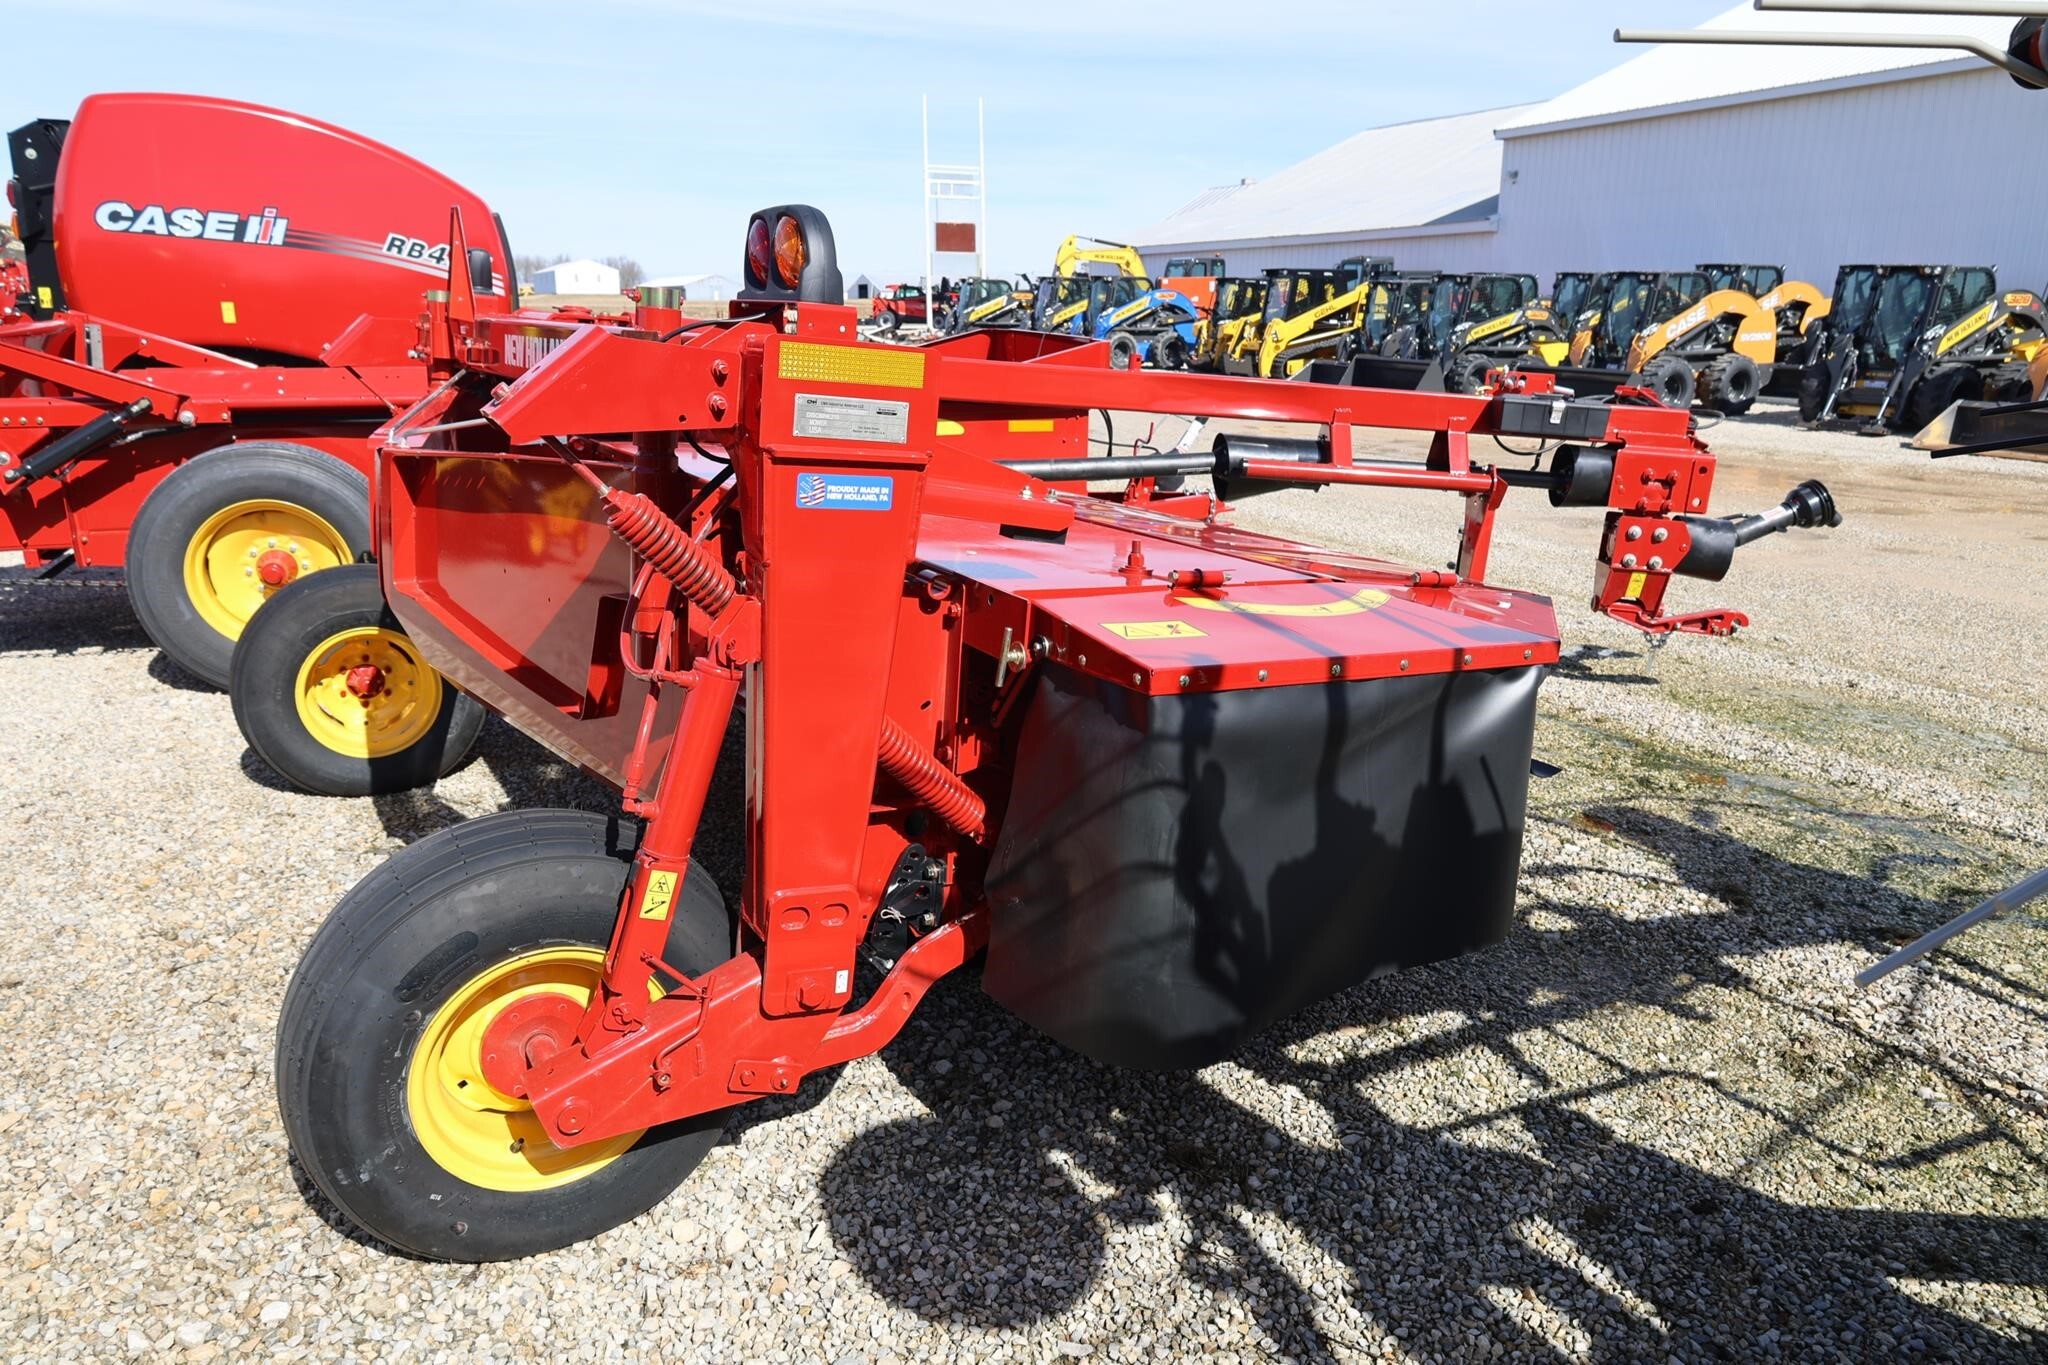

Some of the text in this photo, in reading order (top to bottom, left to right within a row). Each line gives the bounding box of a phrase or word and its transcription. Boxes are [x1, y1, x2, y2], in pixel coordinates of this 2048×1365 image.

[95, 200, 240, 241] CASE
[384, 233, 449, 266] RB4
[1314, 304, 1336, 318] GEHL
[1762, 294, 1780, 310] SE
[1667, 304, 1707, 338] CASE
[504, 333, 525, 368] NEW
[827, 485, 859, 493] PROUDLY
[860, 486, 880, 494] MADE
[843, 494, 878, 502] HOLLAND,
